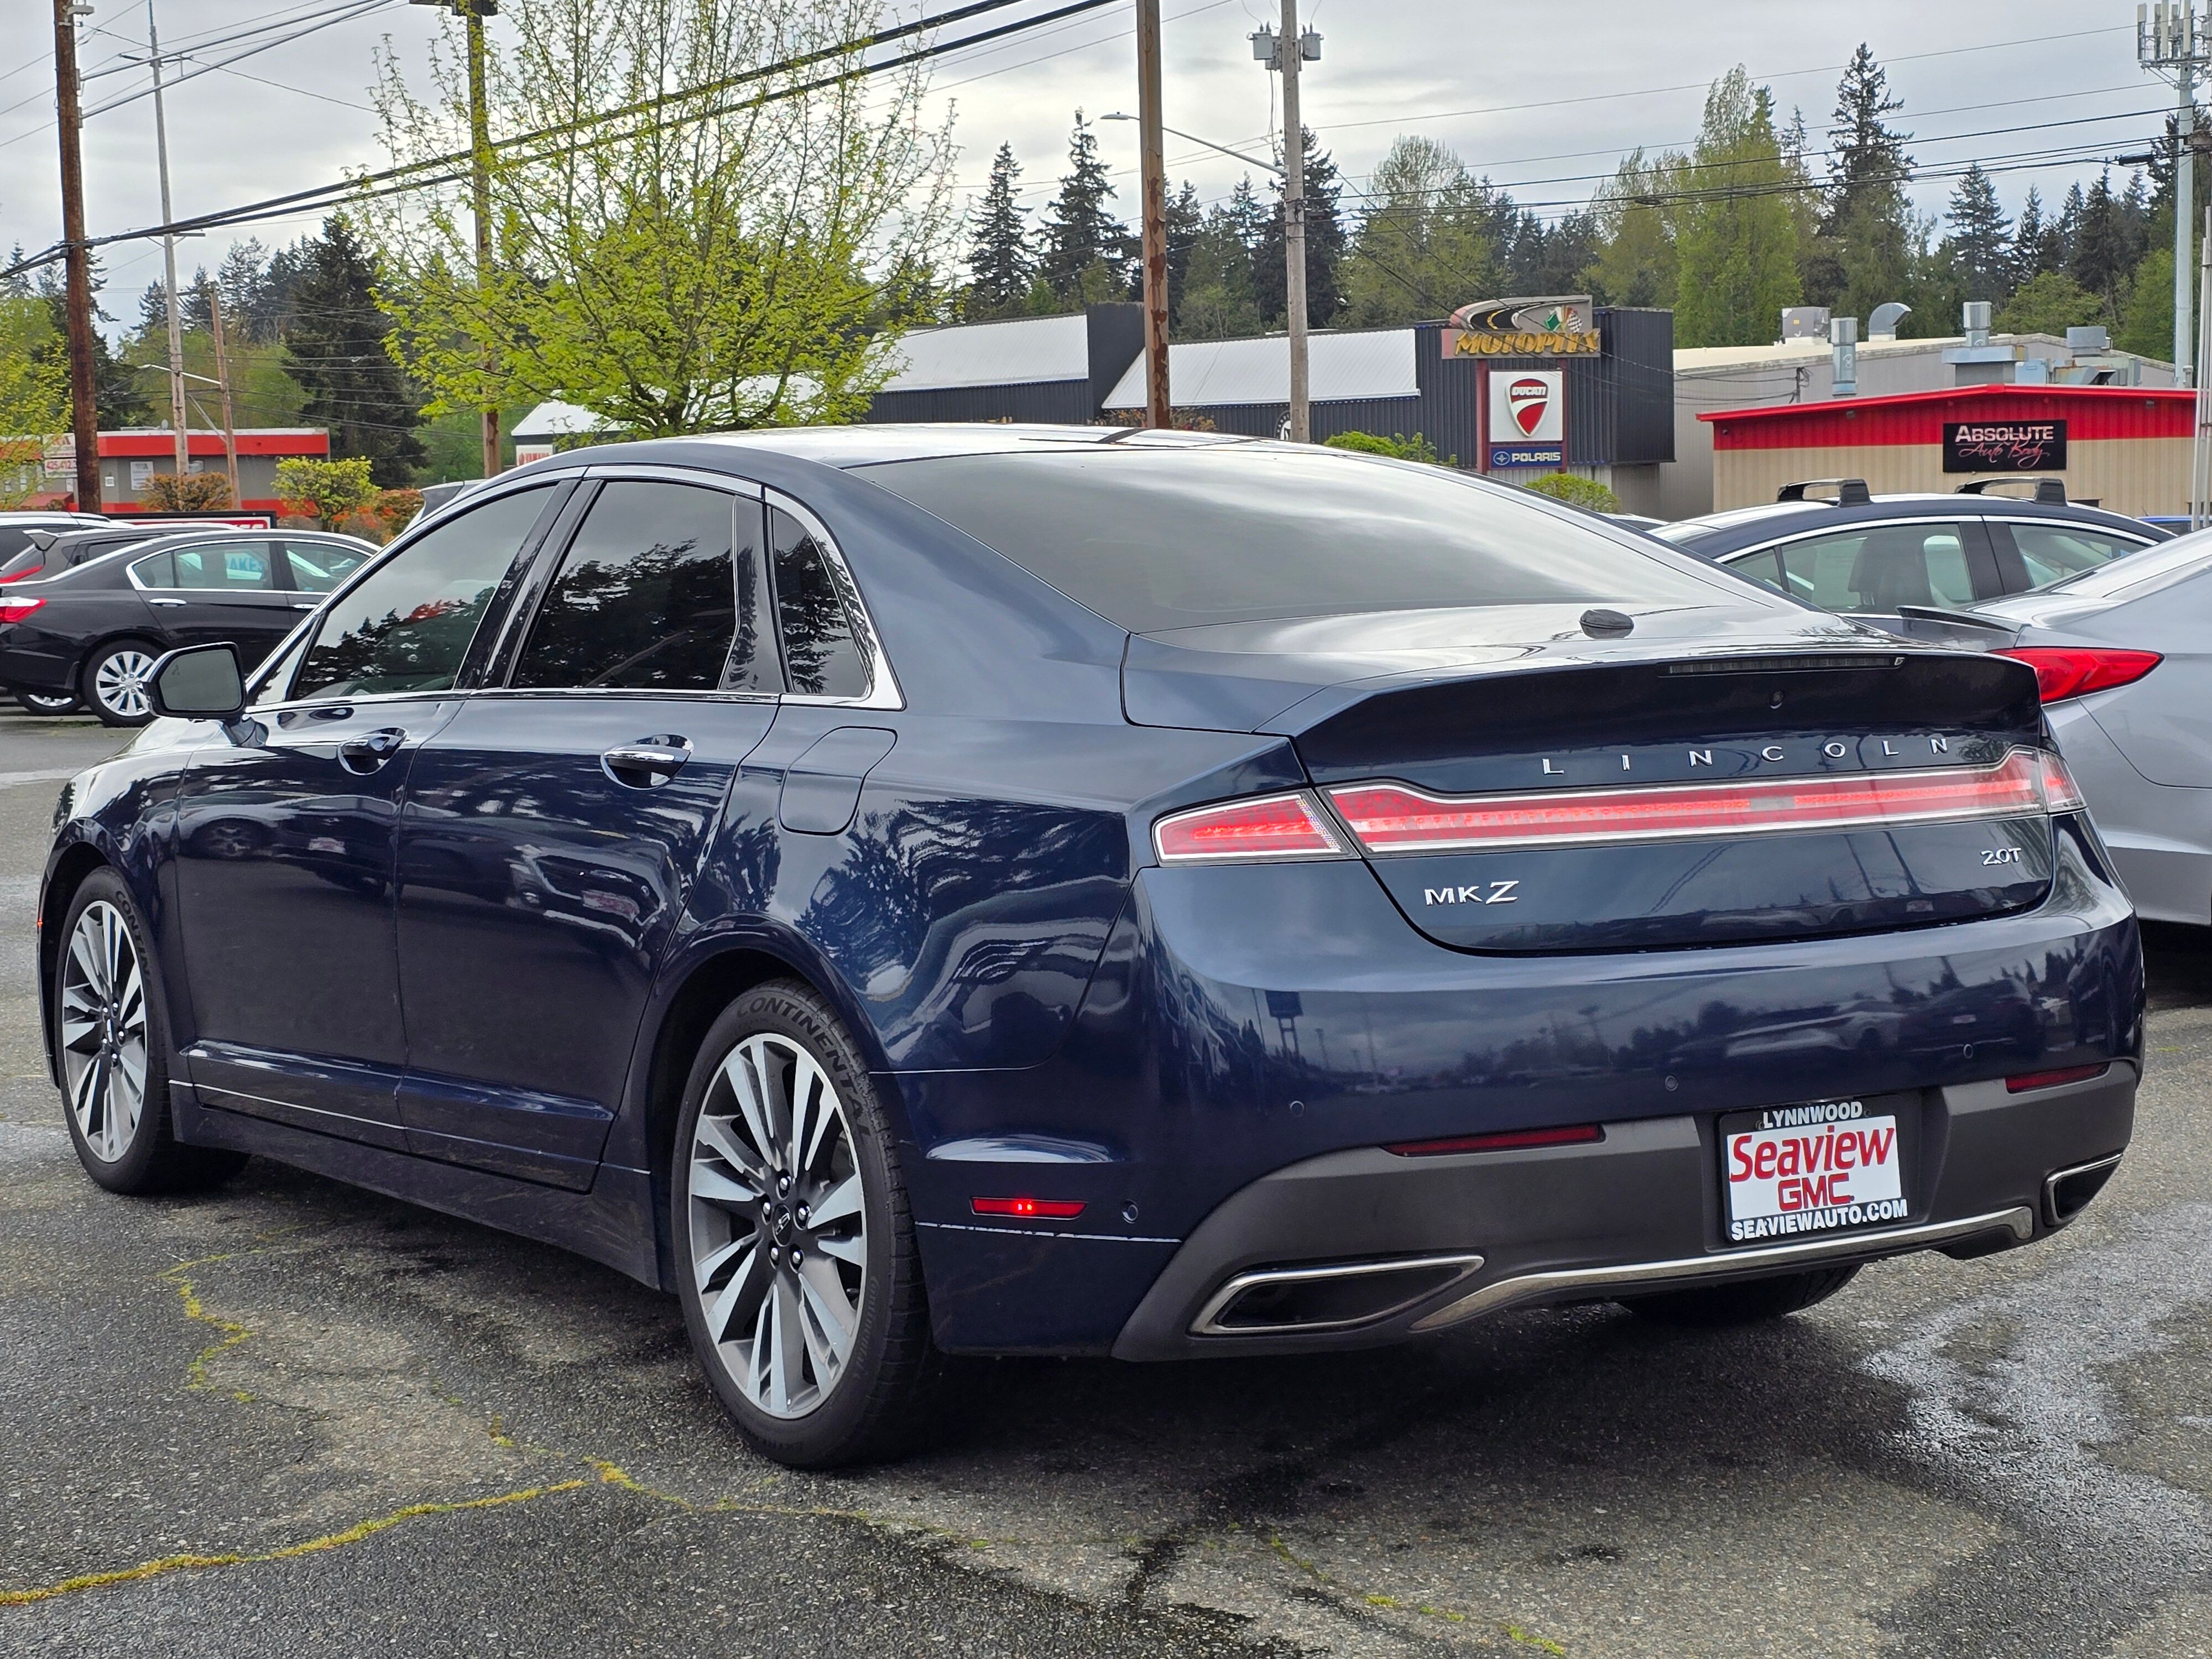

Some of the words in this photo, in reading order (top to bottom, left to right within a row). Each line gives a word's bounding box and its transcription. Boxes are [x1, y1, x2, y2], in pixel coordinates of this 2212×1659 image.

[1455, 332, 1600, 356] MOTOPLEX
[1511, 387, 1547, 396] DUCATI
[1955, 425, 2054, 442] ABSOLUTE
[1511, 452, 1562, 463] POLARIS
[1958, 442, 2005, 463] Auto
[2007, 435, 2051, 469] Body
[1542, 738, 1949, 775] LINCOLN
[1424, 880, 1520, 906] MKZ
[1763, 1101, 1863, 1129] LYNNWOOD
[1729, 1125, 1895, 1183] Seaview
[1778, 1172, 1851, 1212] GMC
[1731, 1199, 1908, 1241] SEAVIEWAUTO.COM
